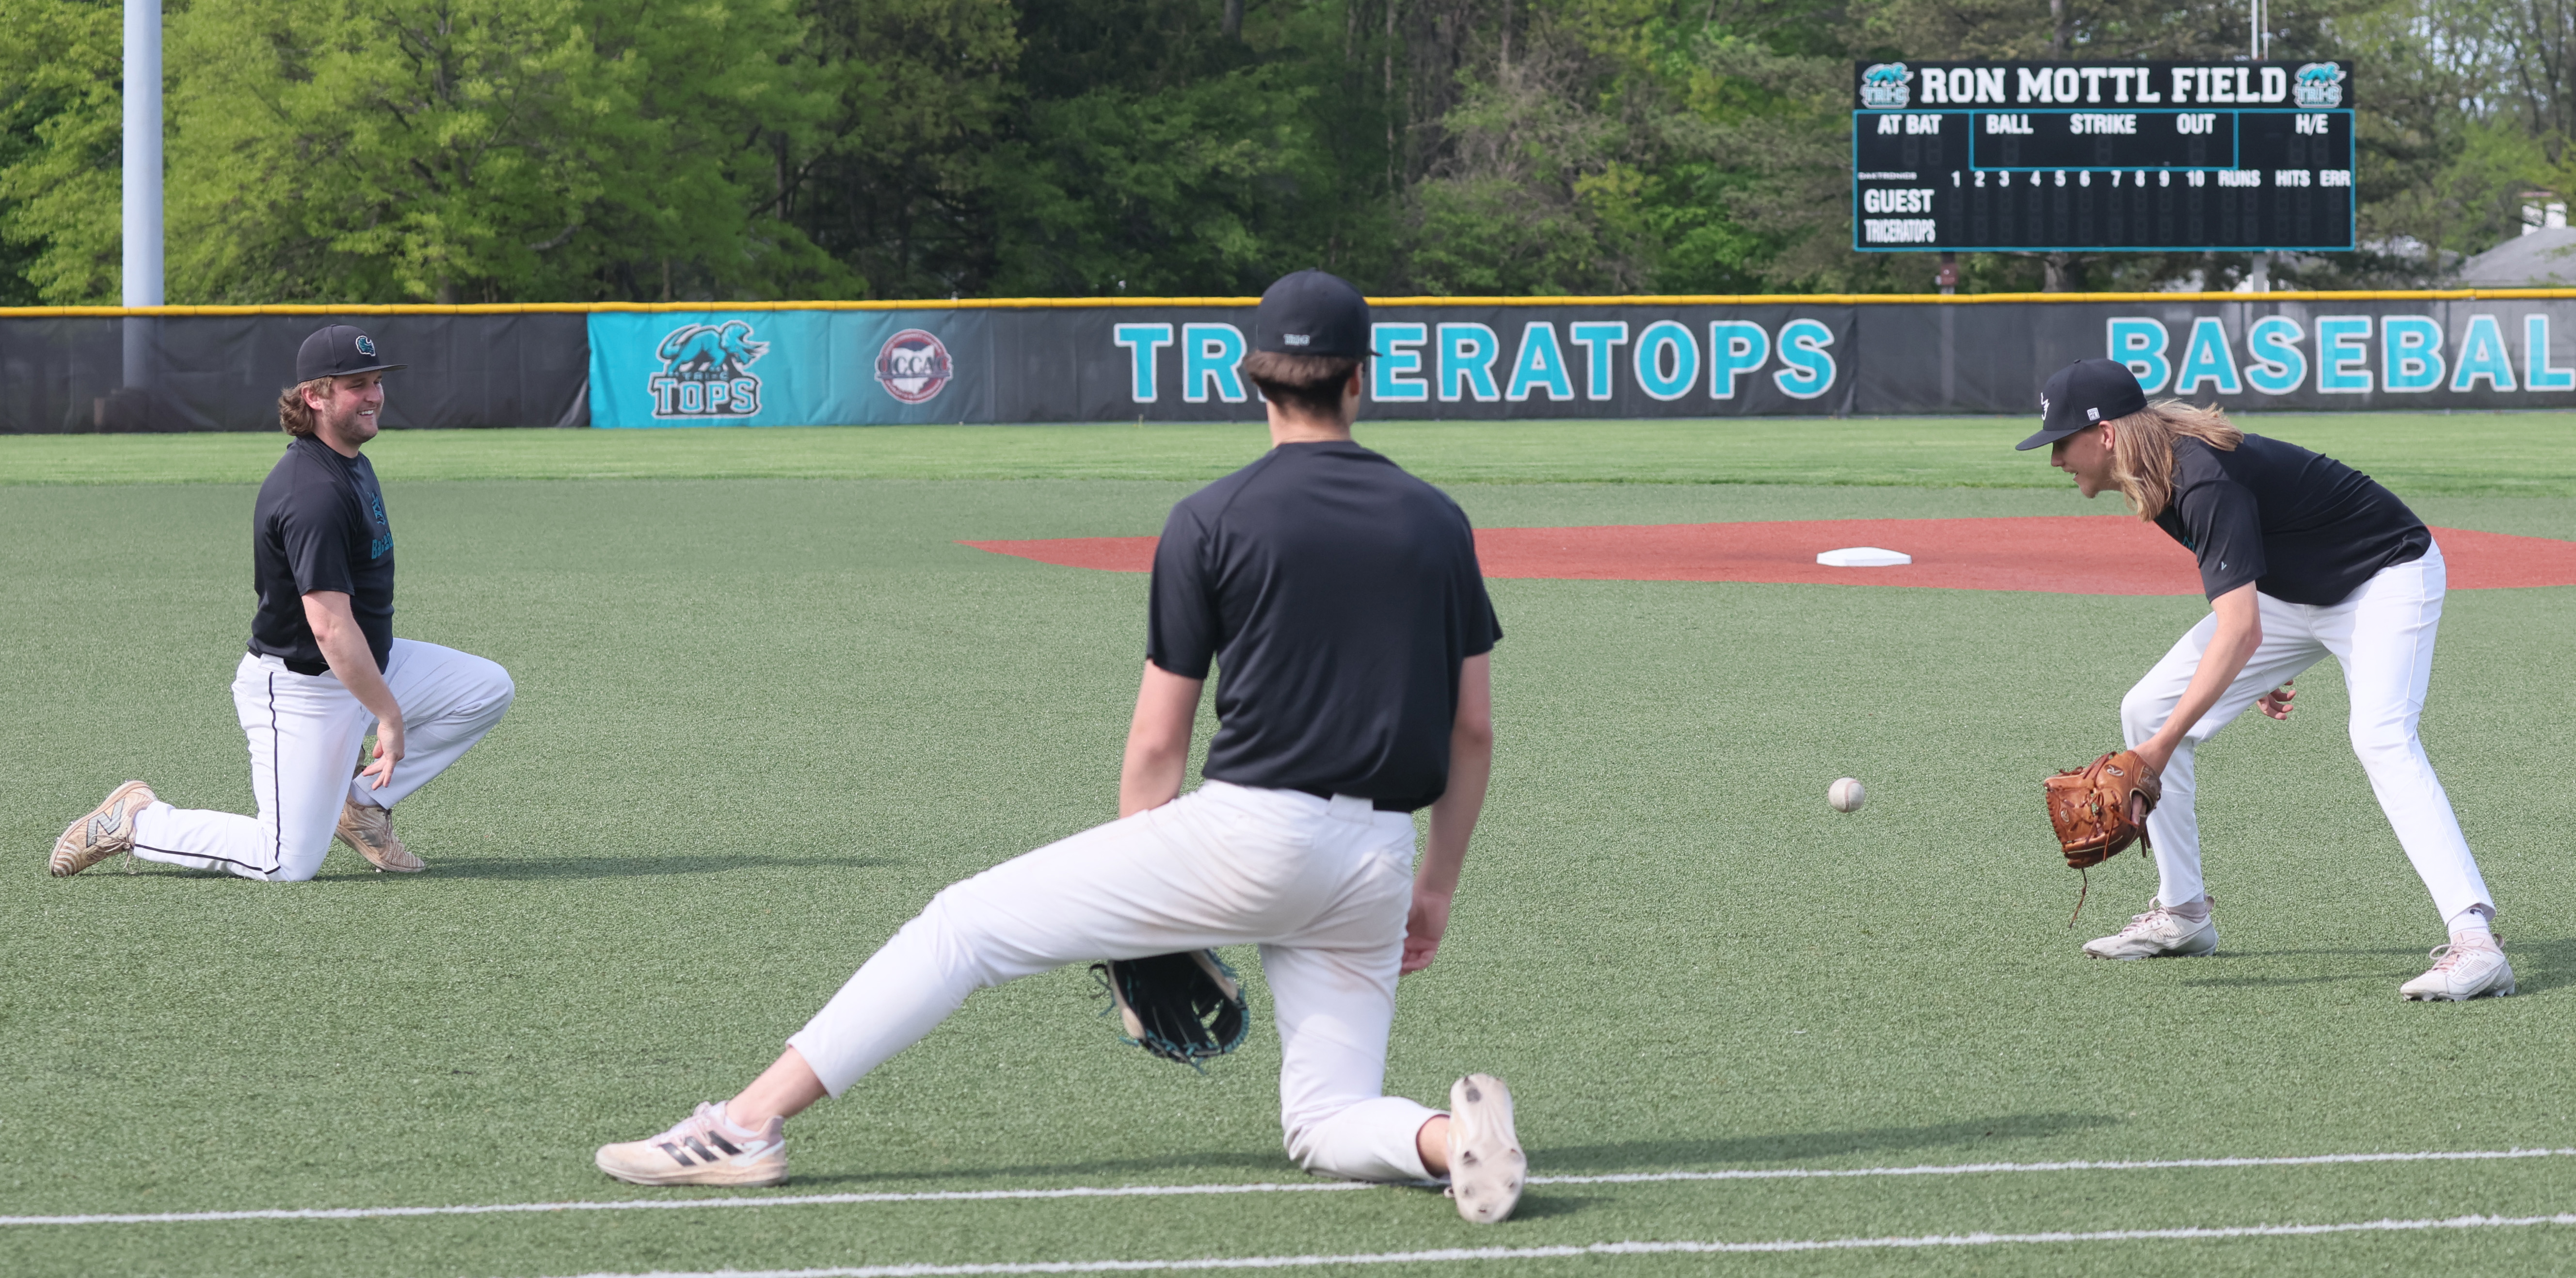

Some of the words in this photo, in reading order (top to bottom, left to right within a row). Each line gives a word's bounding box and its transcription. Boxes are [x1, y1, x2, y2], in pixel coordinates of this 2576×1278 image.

[1920, 67, 2006, 103] RON
[2016, 67, 2160, 103] MOTTL
[2171, 67, 2287, 103] FIELD
[1877, 114, 1903, 135] AT
[1905, 114, 1942, 135] BAT
[1986, 113, 2034, 134] BALL
[2069, 113, 2137, 135] STRIKE
[2176, 113, 2216, 135] OUT
[2295, 113, 2329, 136] H/E
[1951, 170, 1961, 187] 1
[1974, 170, 1985, 187] 2
[1999, 170, 2010, 187] 3
[2030, 170, 2042, 187] 4
[2054, 170, 2066, 187] 5
[2079, 170, 2091, 187] 6
[2111, 170, 2122, 187] 7
[2134, 170, 2146, 187] 8
[2159, 170, 2170, 187] 9
[2185, 170, 2205, 187] 10
[2217, 169, 2261, 187] RUNS
[2274, 169, 2311, 187] HITS
[2319, 169, 2351, 187] ERR
[1864, 189, 1935, 213] GUEST
[1864, 219, 1936, 243] TRICERATOPS
[878, 356, 949, 376] OCCAC
[1114, 319, 1837, 402] TRERATOPS
[653, 378, 755, 415] TOPS
